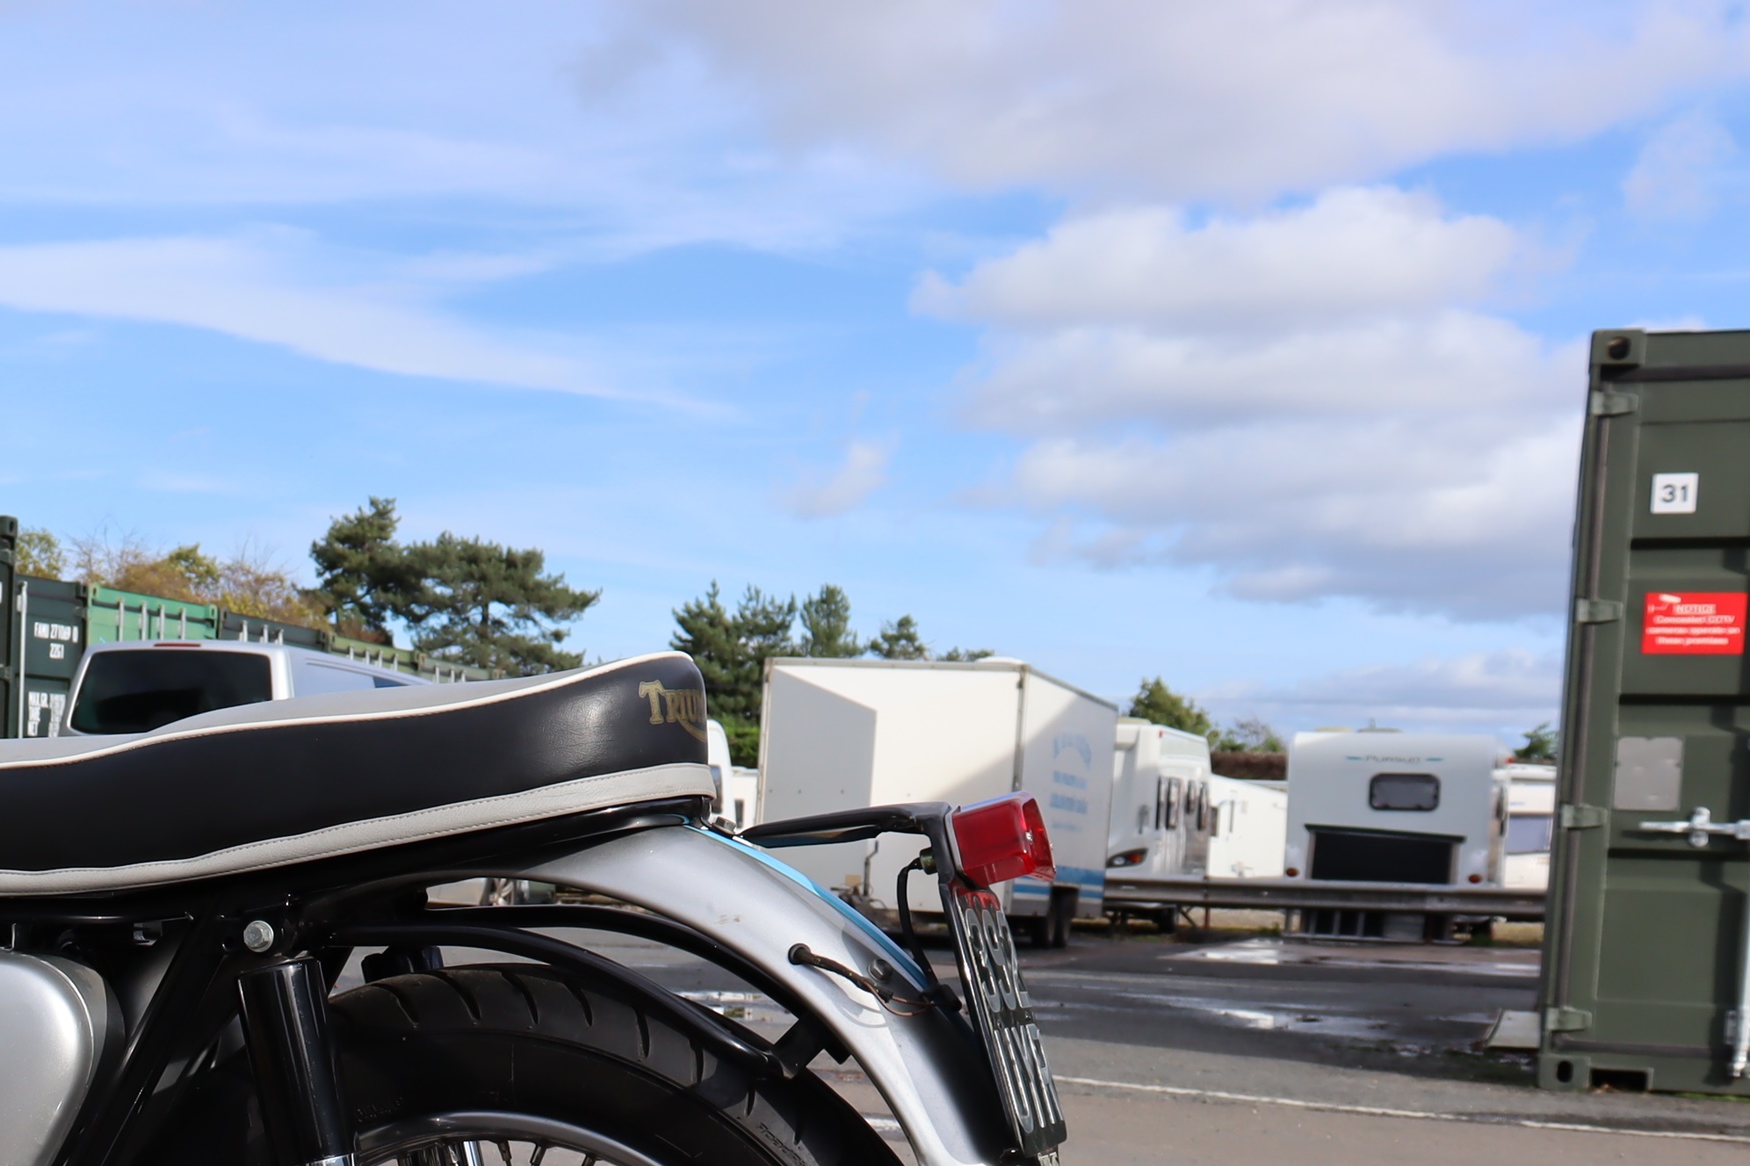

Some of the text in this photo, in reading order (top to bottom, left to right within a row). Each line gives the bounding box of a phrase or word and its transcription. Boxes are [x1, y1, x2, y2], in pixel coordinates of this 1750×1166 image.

[1662, 484, 1688, 503] 31
[1672, 604, 1716, 614] NOTICE
[965, 908, 1032, 1012] 392
